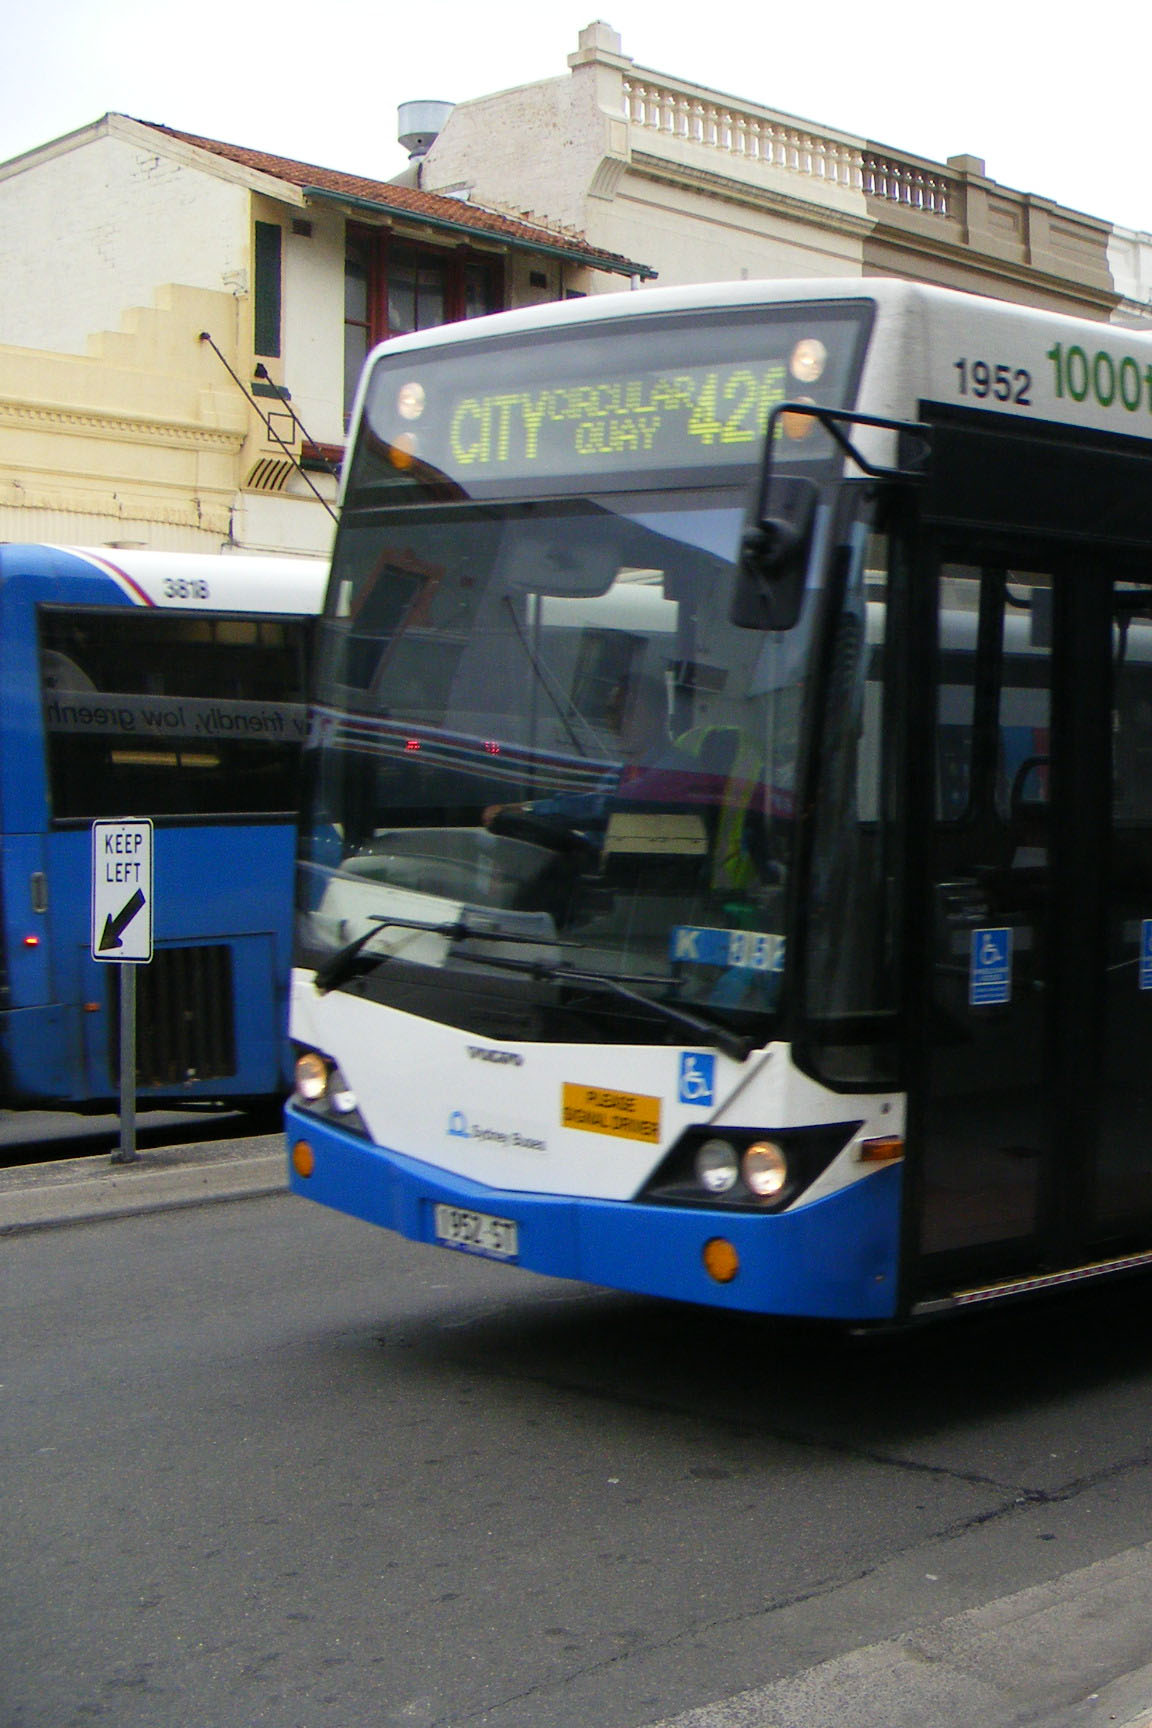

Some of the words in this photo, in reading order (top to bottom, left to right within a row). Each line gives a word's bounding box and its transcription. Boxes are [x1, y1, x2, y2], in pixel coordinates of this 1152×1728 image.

[954, 357, 1033, 407] 1952
[450, 391, 551, 464] CITY
[548, 375, 696, 421] CIRCULAR
[574, 415, 662, 455] QUAY
[162, 578, 211, 600] 3818
[104, 833, 143, 855] KEEP
[106, 862, 141, 883] LEFT
[585, 1090, 637, 1113] PLEASE
[563, 1105, 609, 1129] SIGNAL
[611, 1114, 660, 1137] DRIVER
[472, 1123, 510, 1145] Sydney
[512, 1132, 548, 1151] Buses
